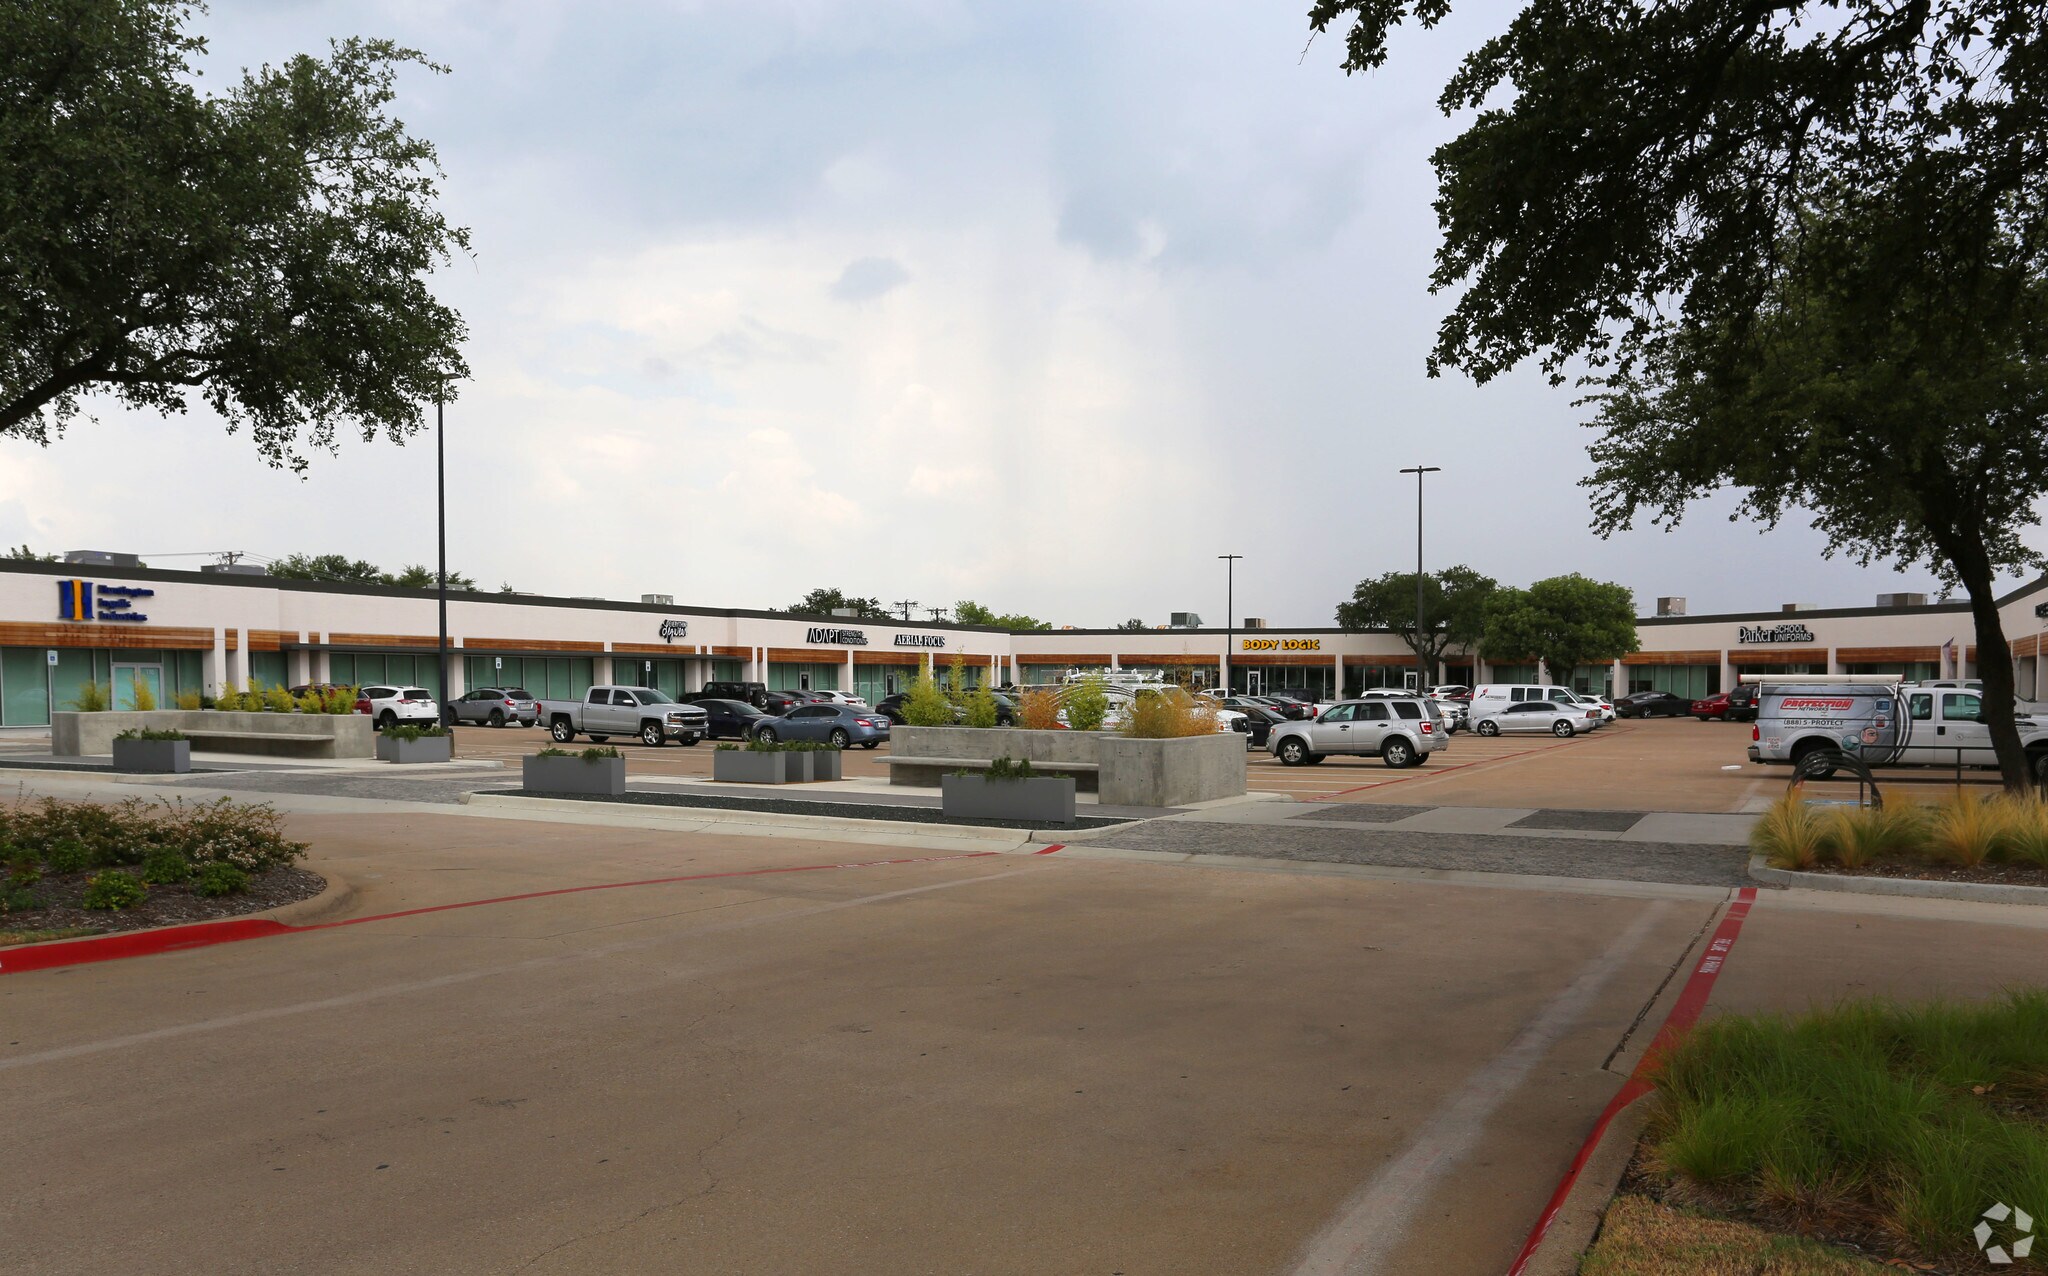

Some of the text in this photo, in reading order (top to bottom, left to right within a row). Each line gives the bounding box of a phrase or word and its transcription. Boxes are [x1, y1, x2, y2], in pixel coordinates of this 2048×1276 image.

[1738, 626, 1814, 643] Parker UNIFORMS
[1775, 624, 1806, 633] SCHOOL
[808, 628, 840, 643] ADAPT
[894, 634, 945, 647] AERIAL FOCUS
[1243, 639, 1320, 650] BODY LOGIC
[1783, 699, 1851, 708] PROTECTION
